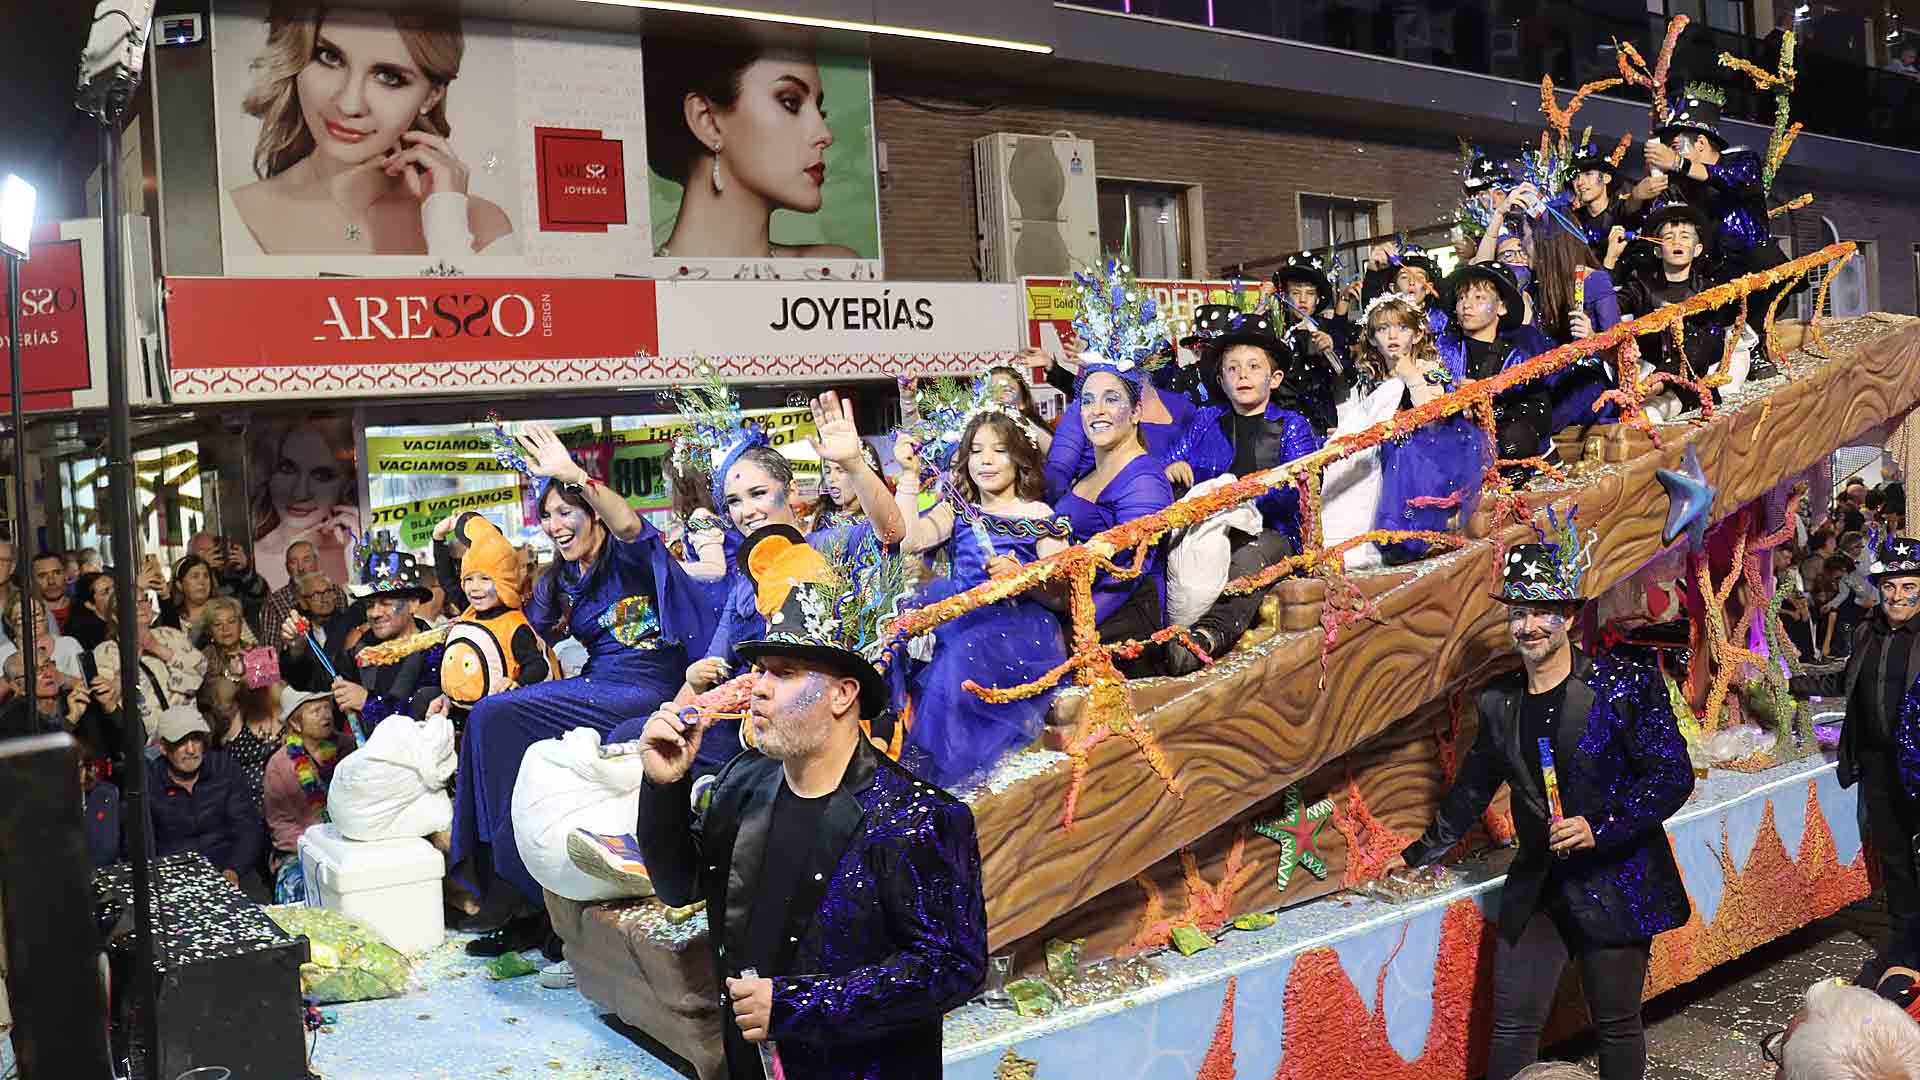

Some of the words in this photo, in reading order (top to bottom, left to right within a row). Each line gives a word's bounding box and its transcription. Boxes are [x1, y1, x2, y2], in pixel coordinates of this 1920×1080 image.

[313, 294, 535, 340] ARESSO
[543, 293, 553, 337] DESIGN
[770, 289, 934, 330] JOYERÍAS
[403, 440, 490, 451] VACIAMOS
[379, 460, 468, 471] VACIAMOS
[428, 490, 513, 511] VACIAMOS
